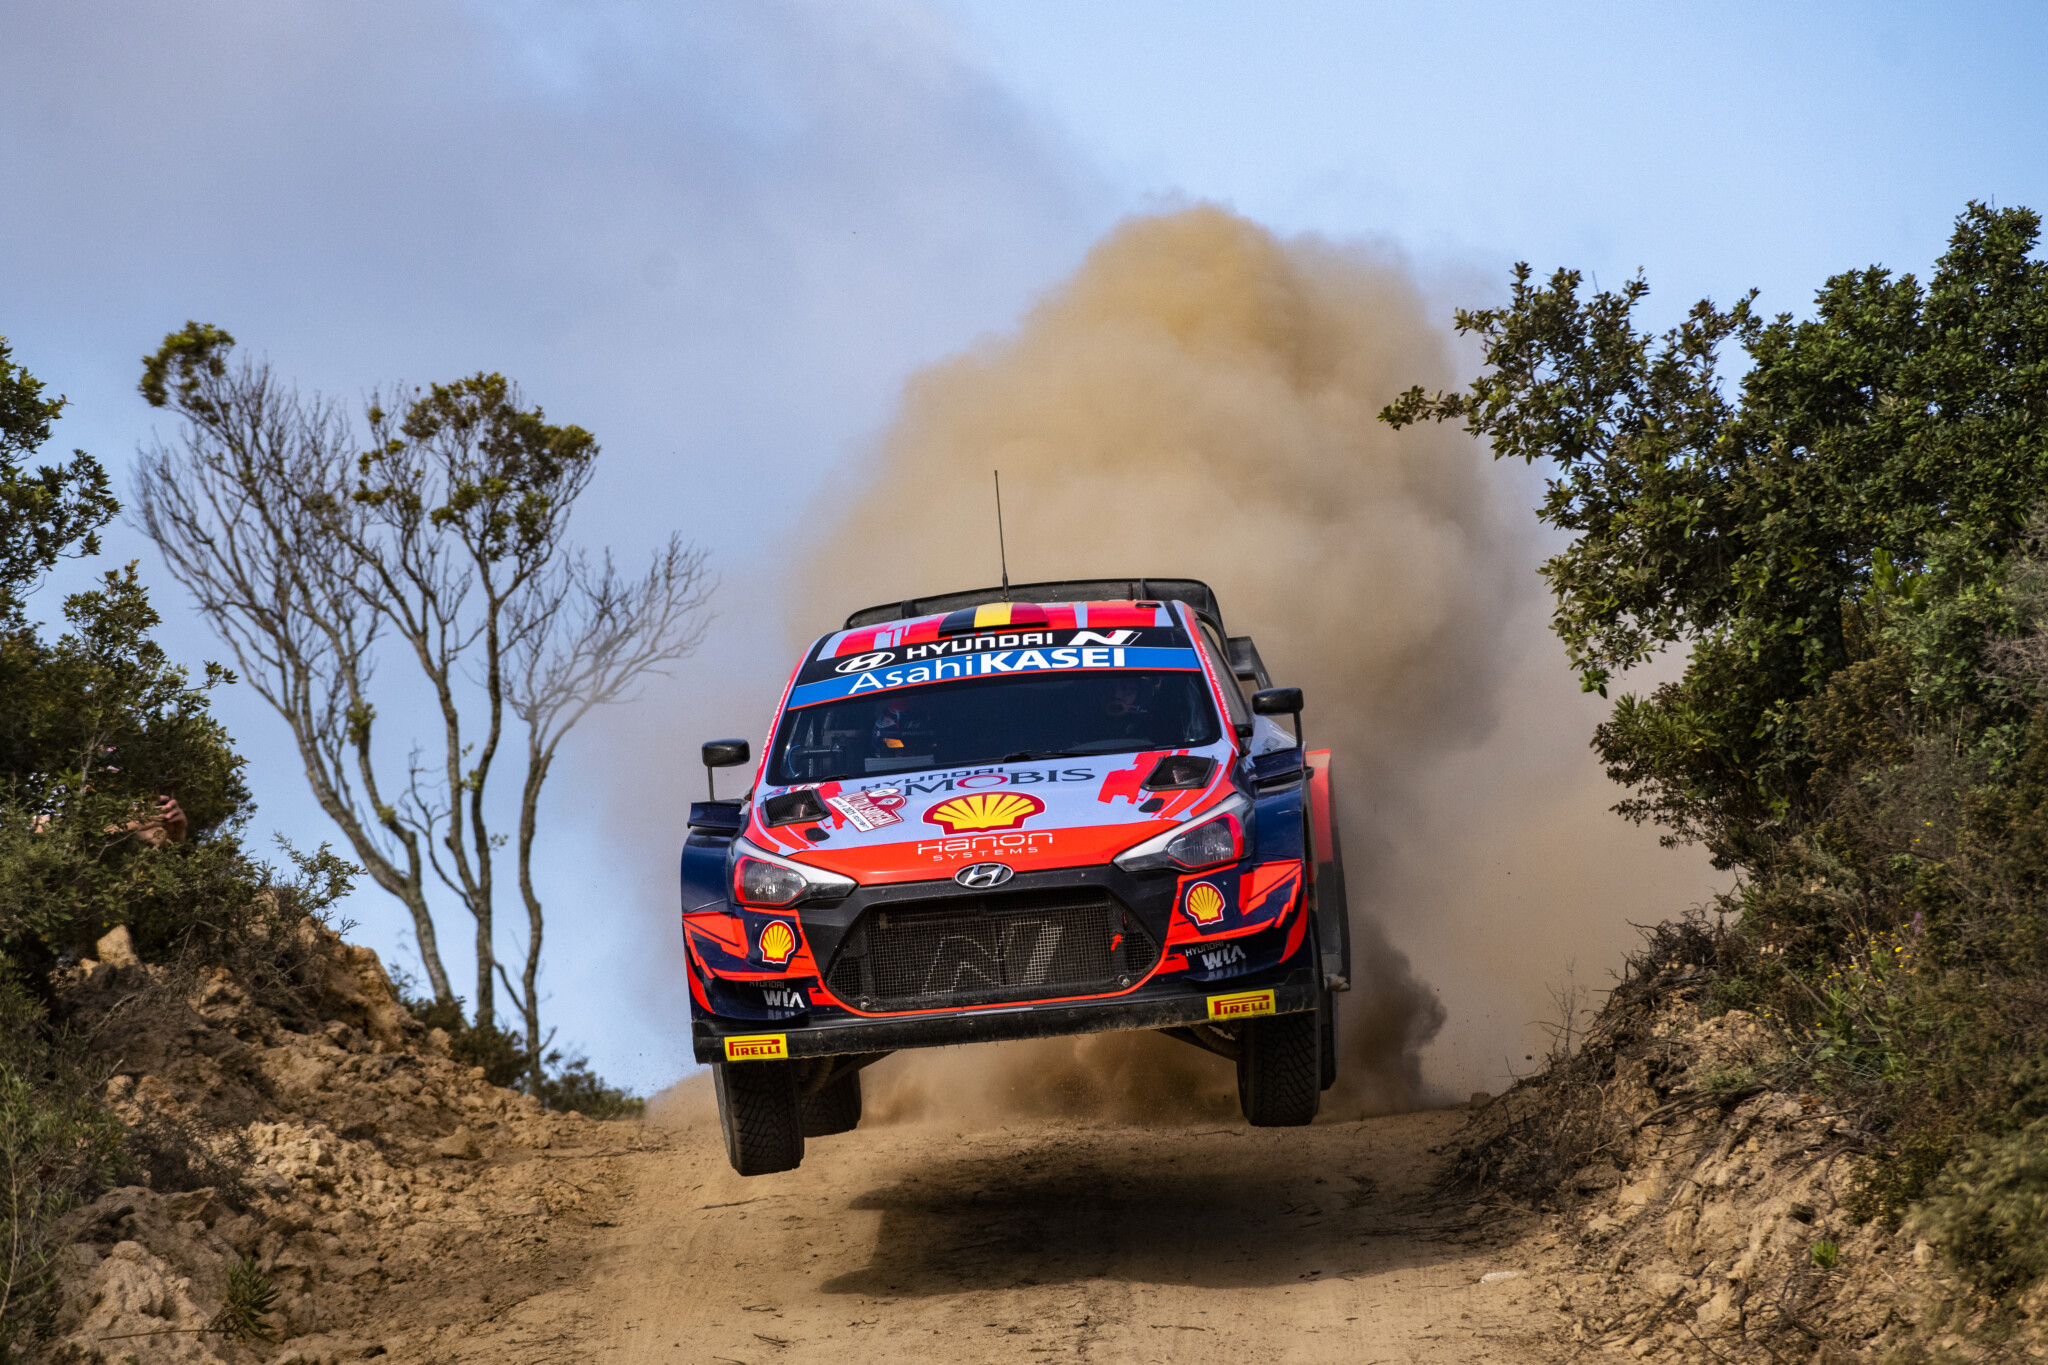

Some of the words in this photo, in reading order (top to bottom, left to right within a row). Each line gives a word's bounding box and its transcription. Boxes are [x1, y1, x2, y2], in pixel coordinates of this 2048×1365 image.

[907, 632, 1053, 660] HYUNDAI
[1067, 630, 1142, 646] N
[860, 767, 1004, 791] HYUNDAI
[905, 768, 1096, 796] MOBIS
[933, 847, 1038, 862] SYSTEMS
[1185, 940, 1225, 957] HYUNDAI
[1214, 995, 1270, 1015] PIRELLI
[728, 1039, 781, 1056] PIRELLI
